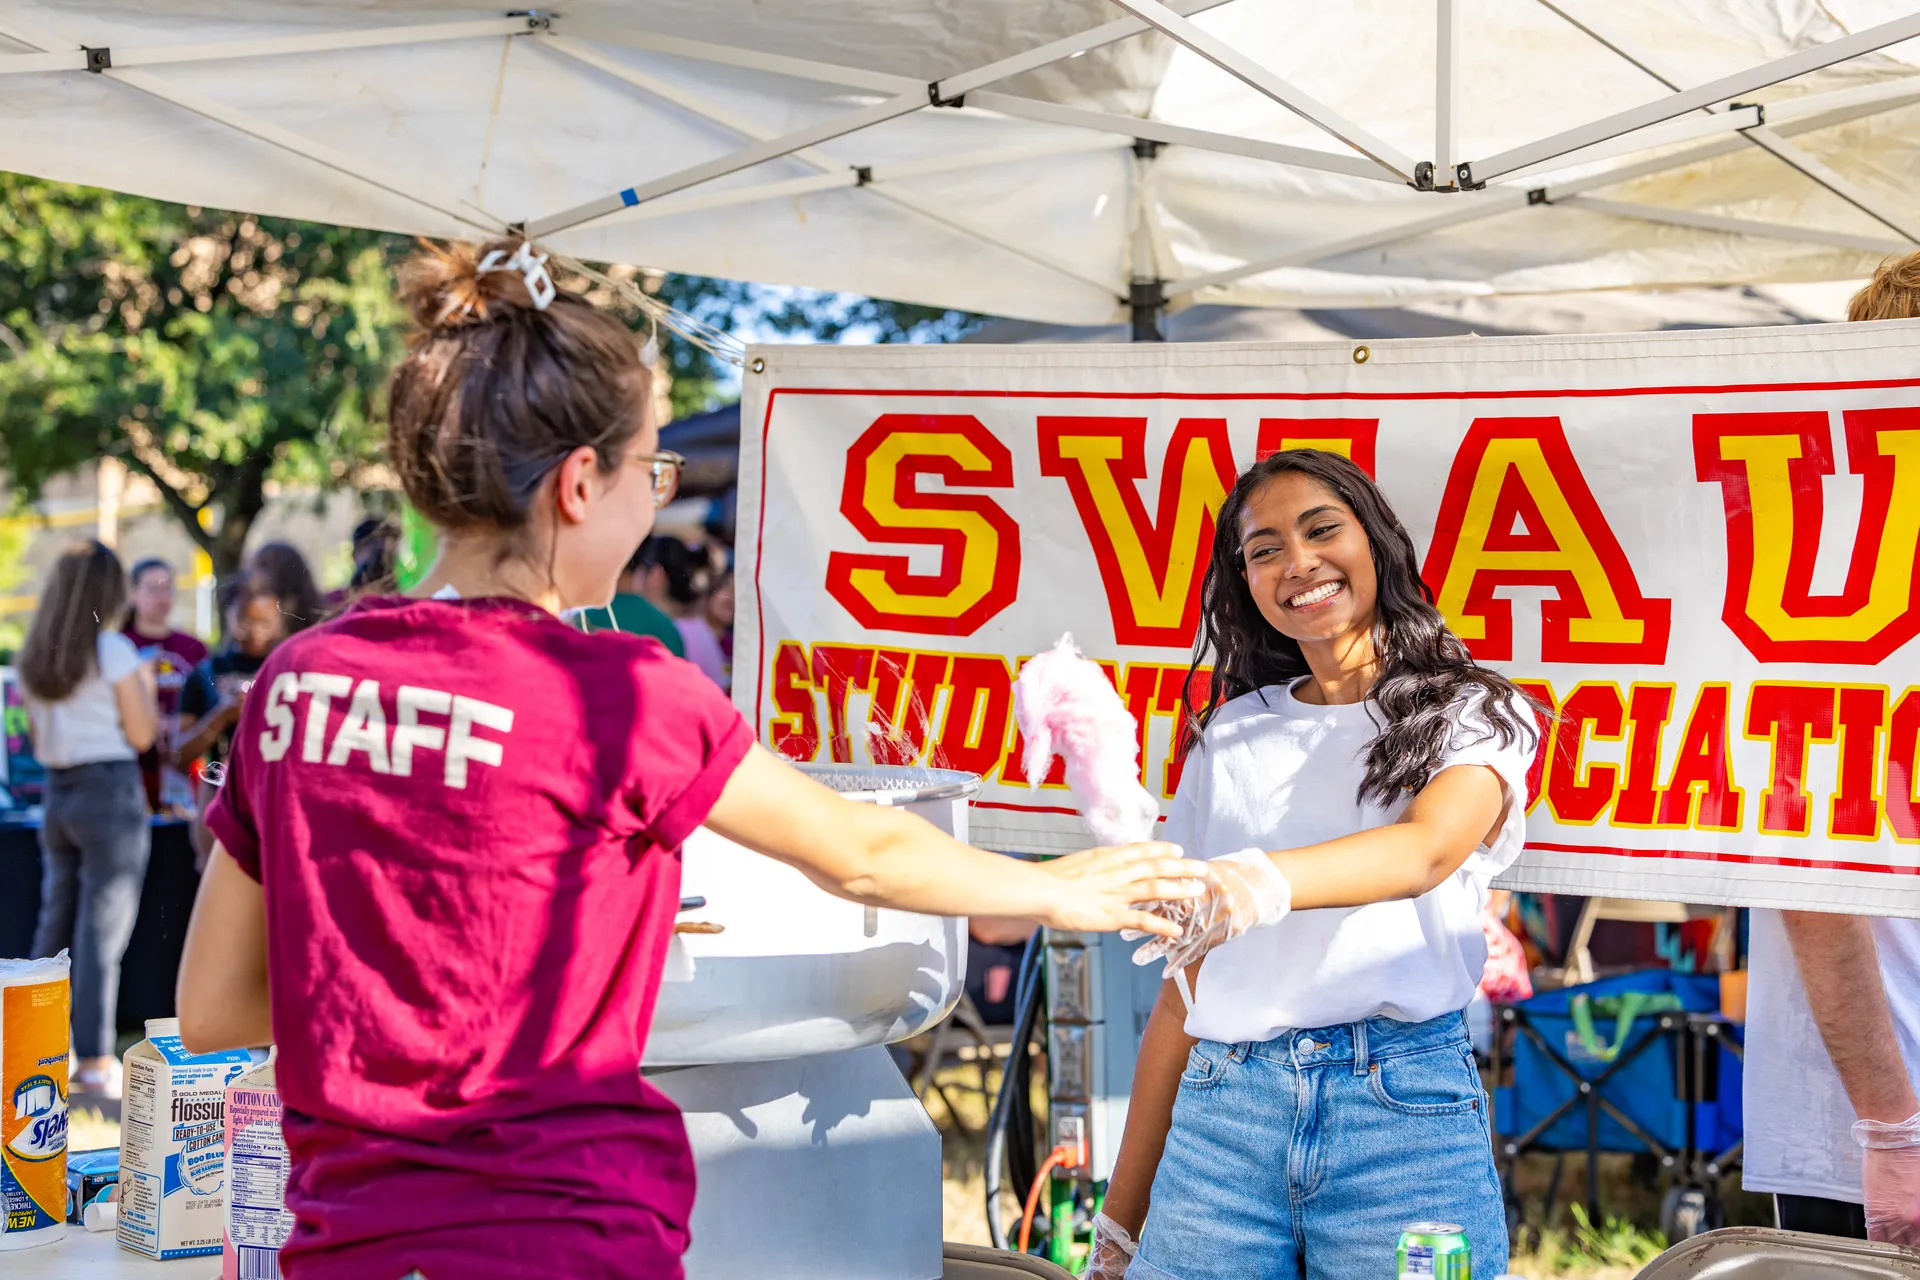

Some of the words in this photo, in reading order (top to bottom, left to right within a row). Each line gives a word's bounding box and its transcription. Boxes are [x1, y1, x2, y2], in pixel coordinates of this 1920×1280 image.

[825, 407, 1920, 665] SWAU
[259, 672, 514, 790] STAFF
[233, 1091, 261, 1106] COTTON
[229, 1105, 250, 1116] Especially
[250, 1107, 270, 1117] prepared
[269, 1109, 278, 1117] mix
[255, 1118, 263, 1126] and
[263, 1119, 274, 1128] tasty
[175, 1122, 216, 1140] READY-TO-USE
[188, 1136, 211, 1151] COTTON
[187, 1155, 205, 1166] BOO
[8, 1215, 36, 1229] NEW
